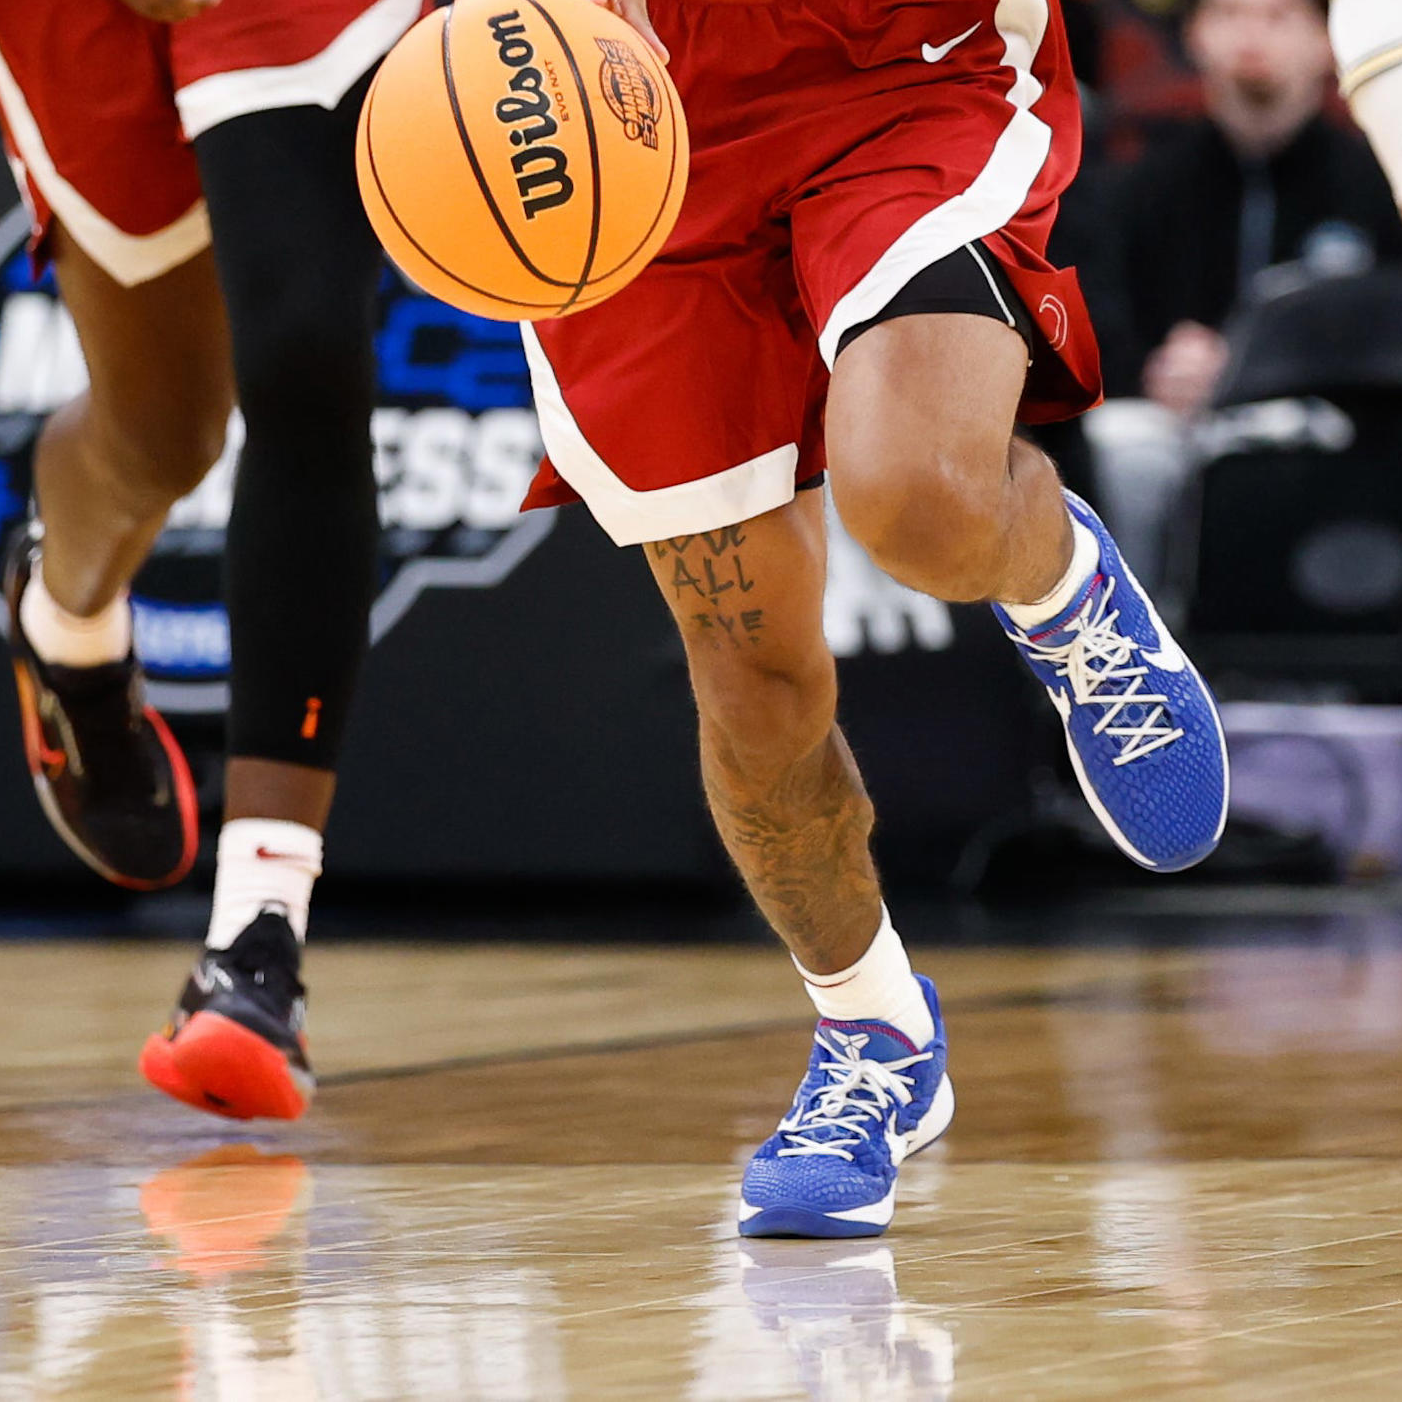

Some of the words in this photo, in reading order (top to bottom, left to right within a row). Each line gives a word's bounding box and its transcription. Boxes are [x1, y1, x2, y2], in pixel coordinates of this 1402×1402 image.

[544, 59, 560, 88] NXT
[609, 62, 638, 121] MARCH
[486, 9, 574, 221] Wilson
[554, 92, 570, 122] EVO
[671, 555, 754, 599] ALL
